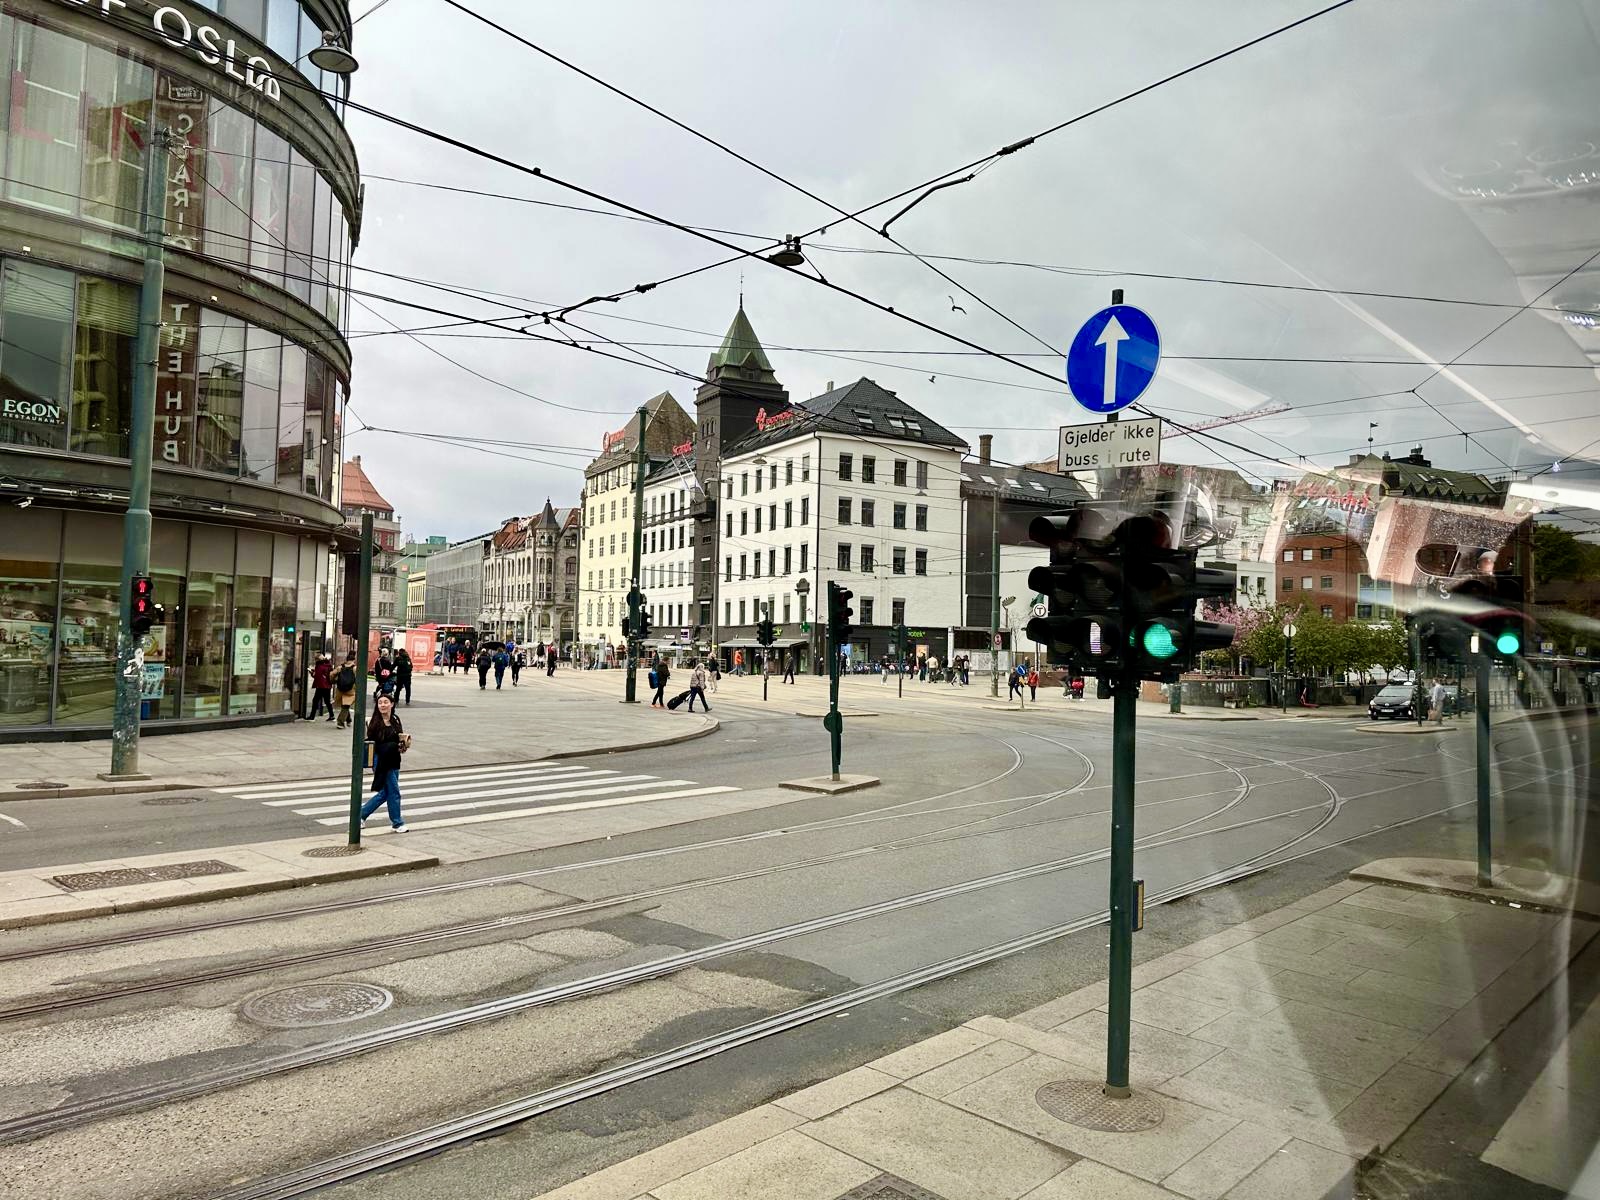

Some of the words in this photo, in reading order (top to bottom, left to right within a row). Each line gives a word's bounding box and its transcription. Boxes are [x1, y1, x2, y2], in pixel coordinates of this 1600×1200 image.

[3, 398, 62, 419] EGON
[1064, 428, 1116, 448] Gjelder
[1123, 424, 1155, 440] ikke
[1065, 453, 1099, 467] buss
[1119, 447, 1151, 463] rute
